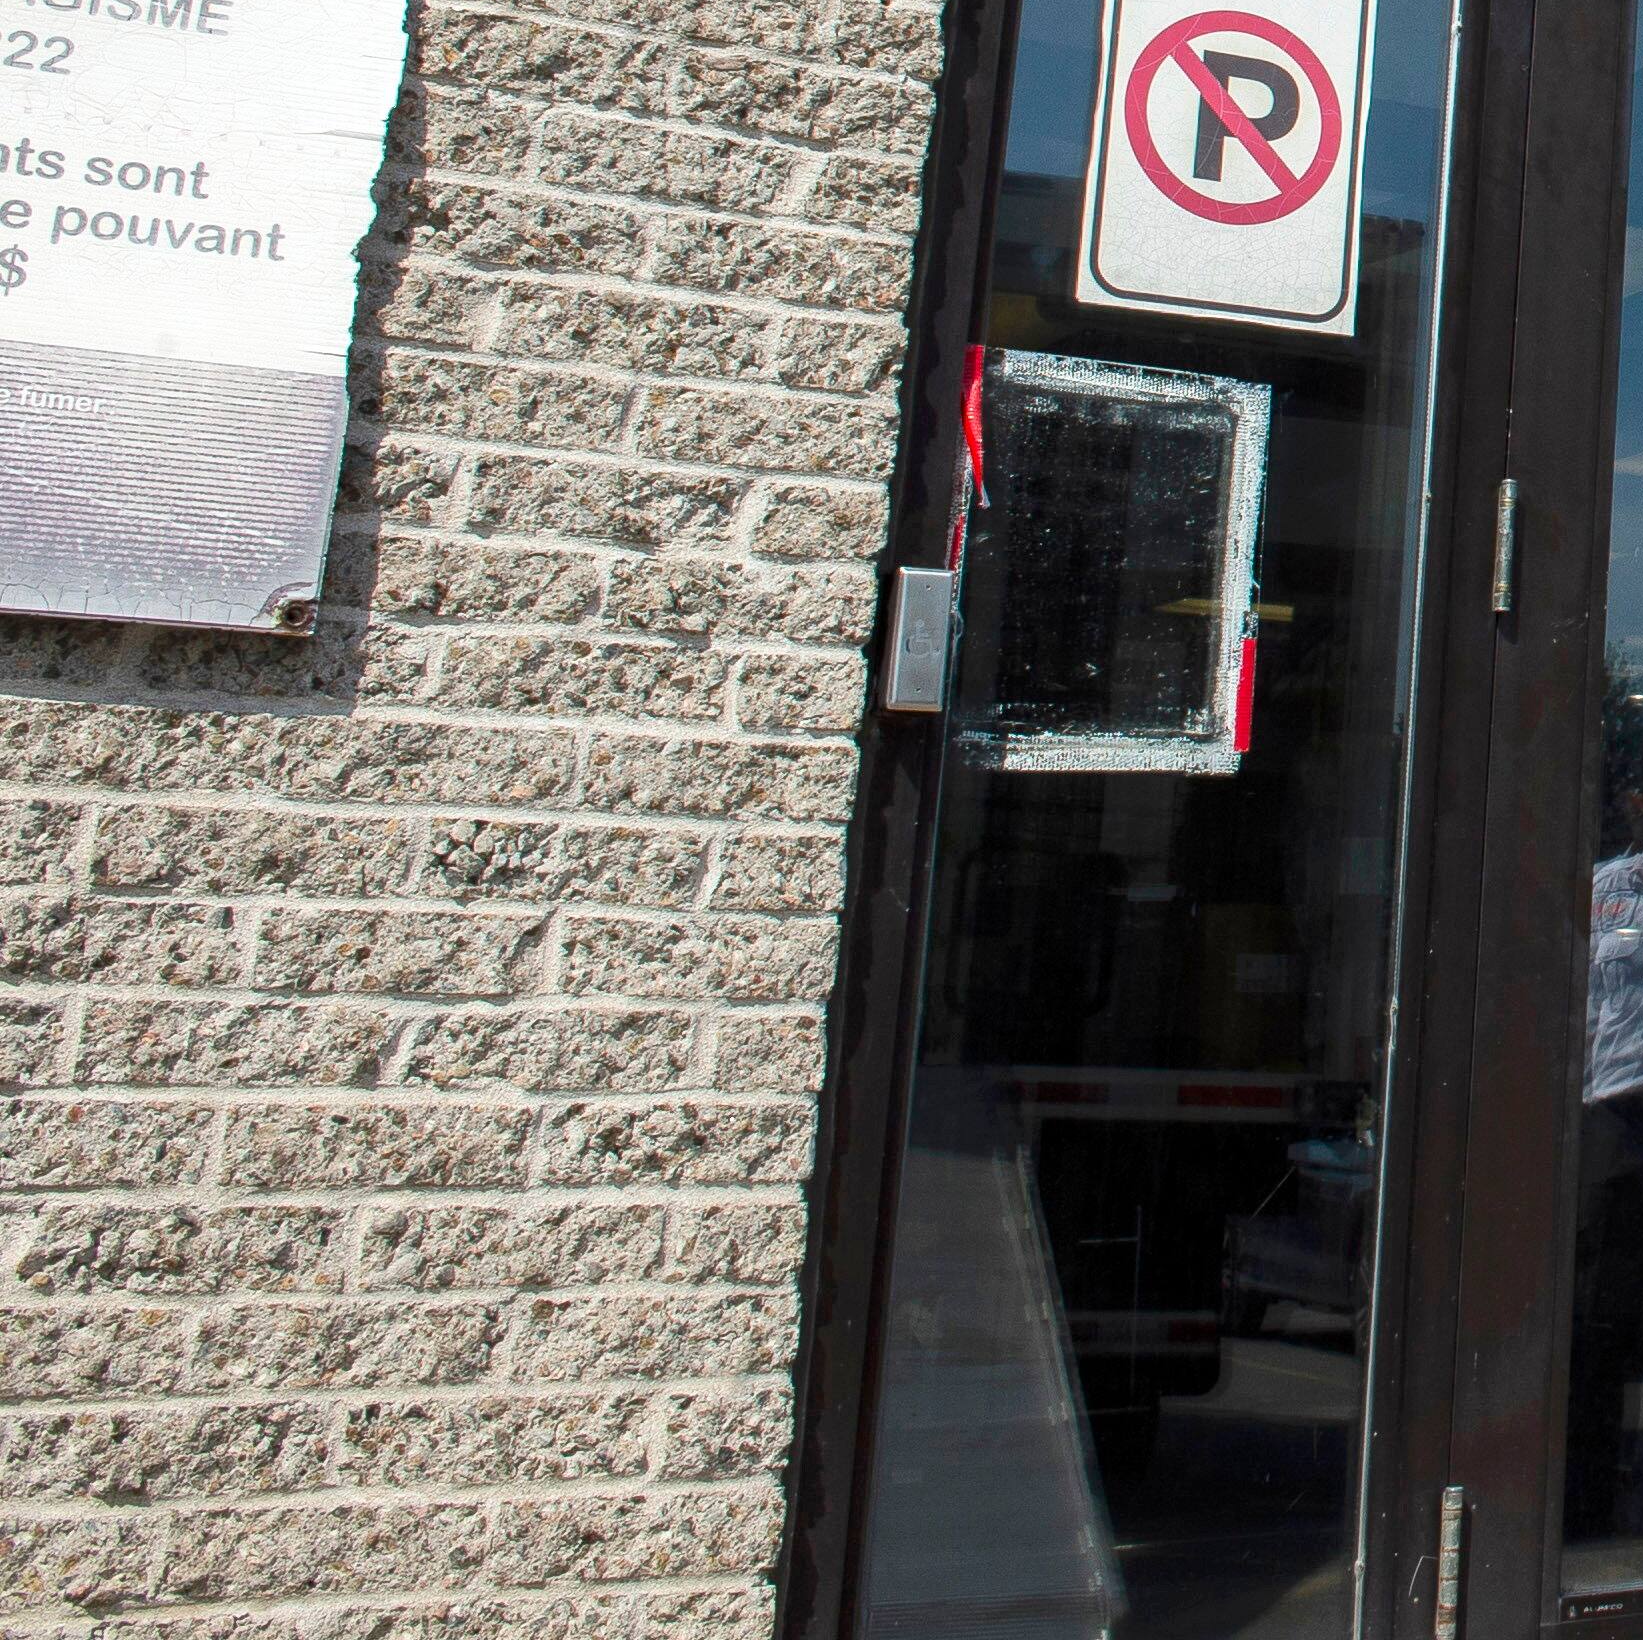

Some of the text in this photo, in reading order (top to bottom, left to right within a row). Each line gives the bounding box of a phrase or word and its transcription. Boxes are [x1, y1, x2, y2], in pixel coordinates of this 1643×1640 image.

[1193, 50, 1299, 181] P
[84, 157, 209, 199] sont
[51, 205, 285, 261] pouvant
